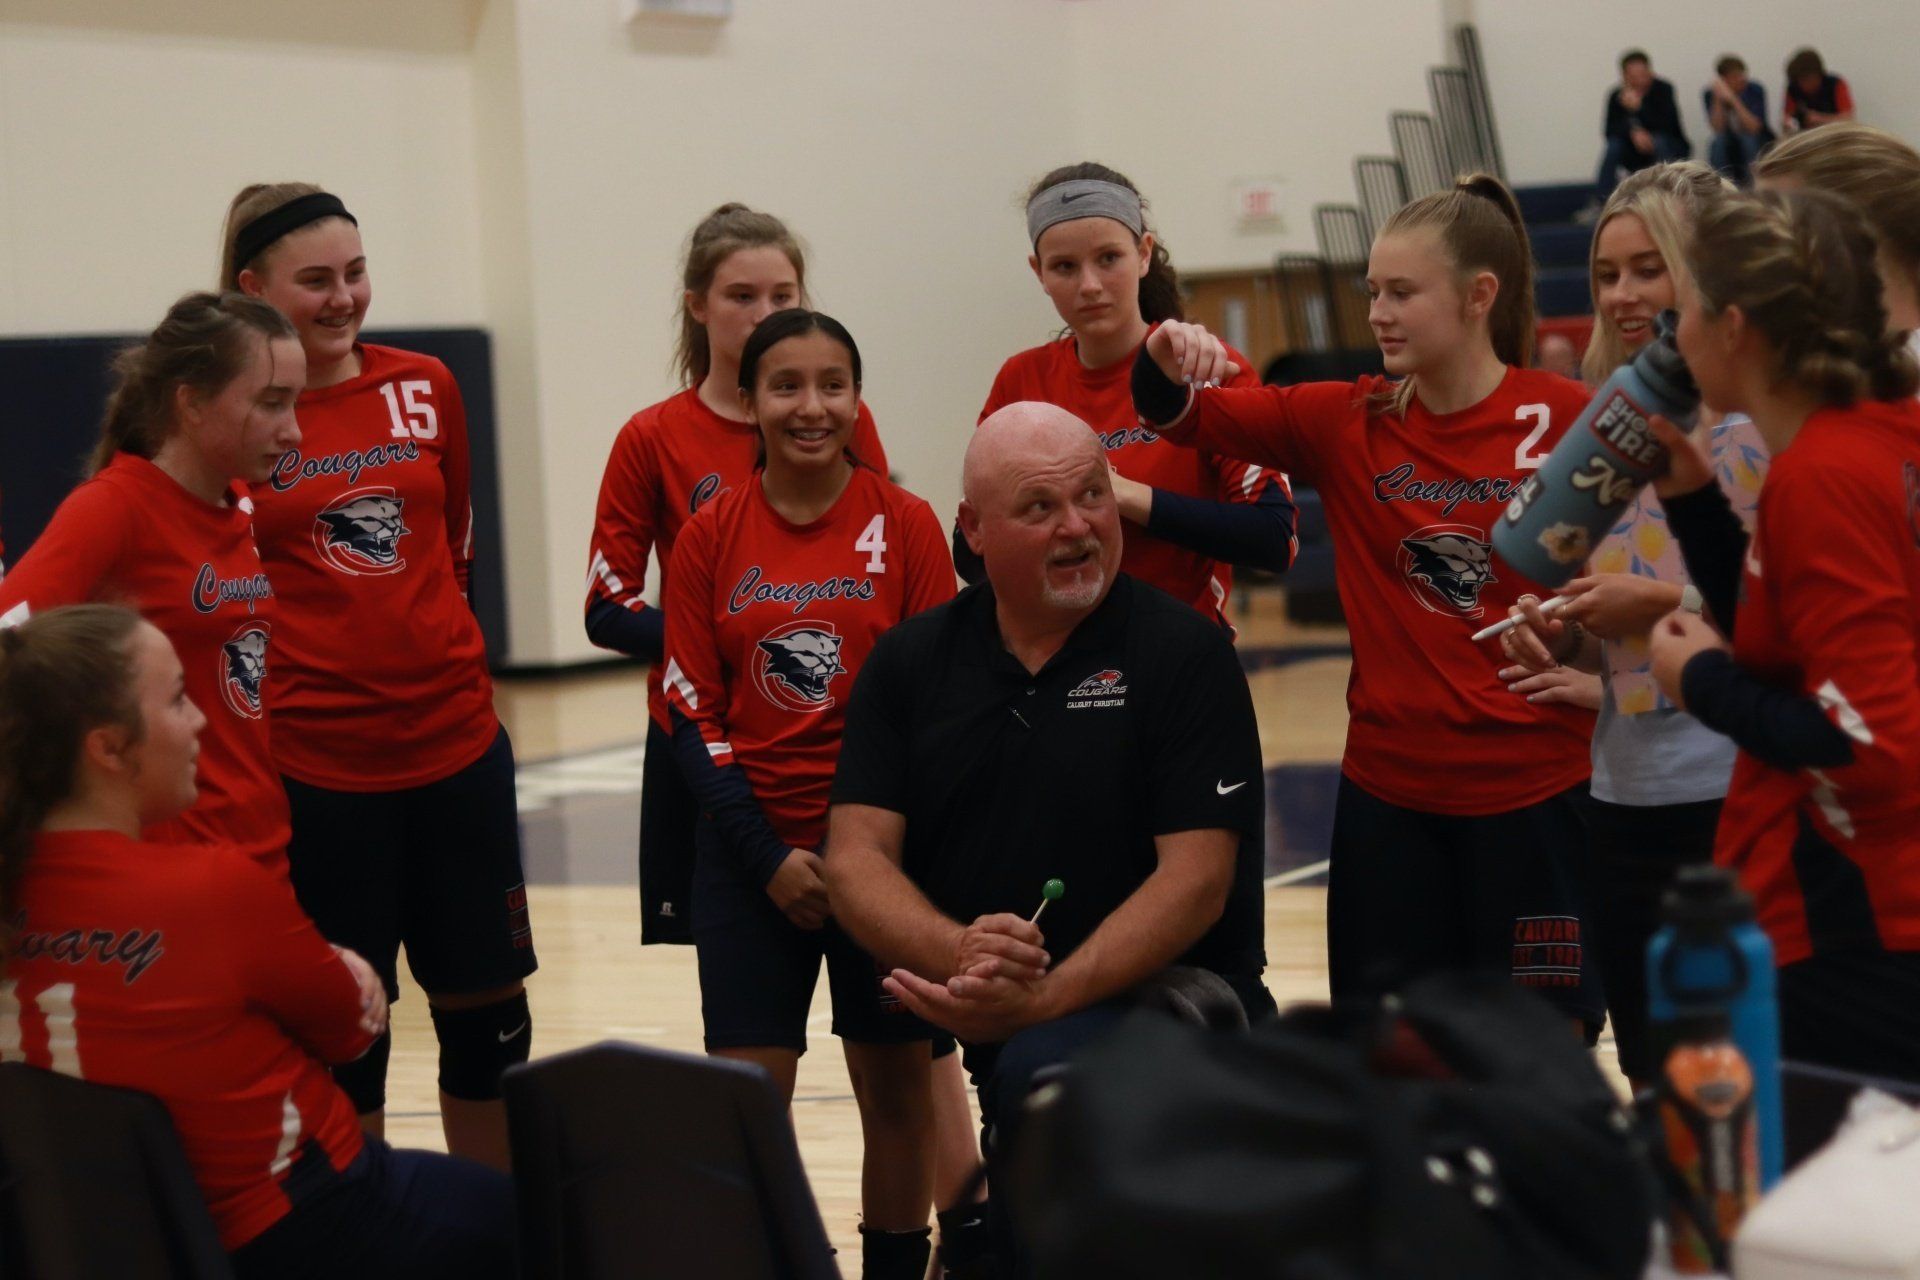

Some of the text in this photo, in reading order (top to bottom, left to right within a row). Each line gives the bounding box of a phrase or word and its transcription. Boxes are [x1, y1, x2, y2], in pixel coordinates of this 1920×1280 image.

[379, 380, 438, 439] 15
[1515, 403, 1550, 469] 2
[1594, 407, 1661, 465] FIRE
[271, 440, 419, 491] Cougars
[855, 514, 887, 573] 4
[728, 566, 875, 614] Cougars
[1067, 685, 1128, 697] COUGARS
[1093, 699, 1125, 707] CHRISTIAN
